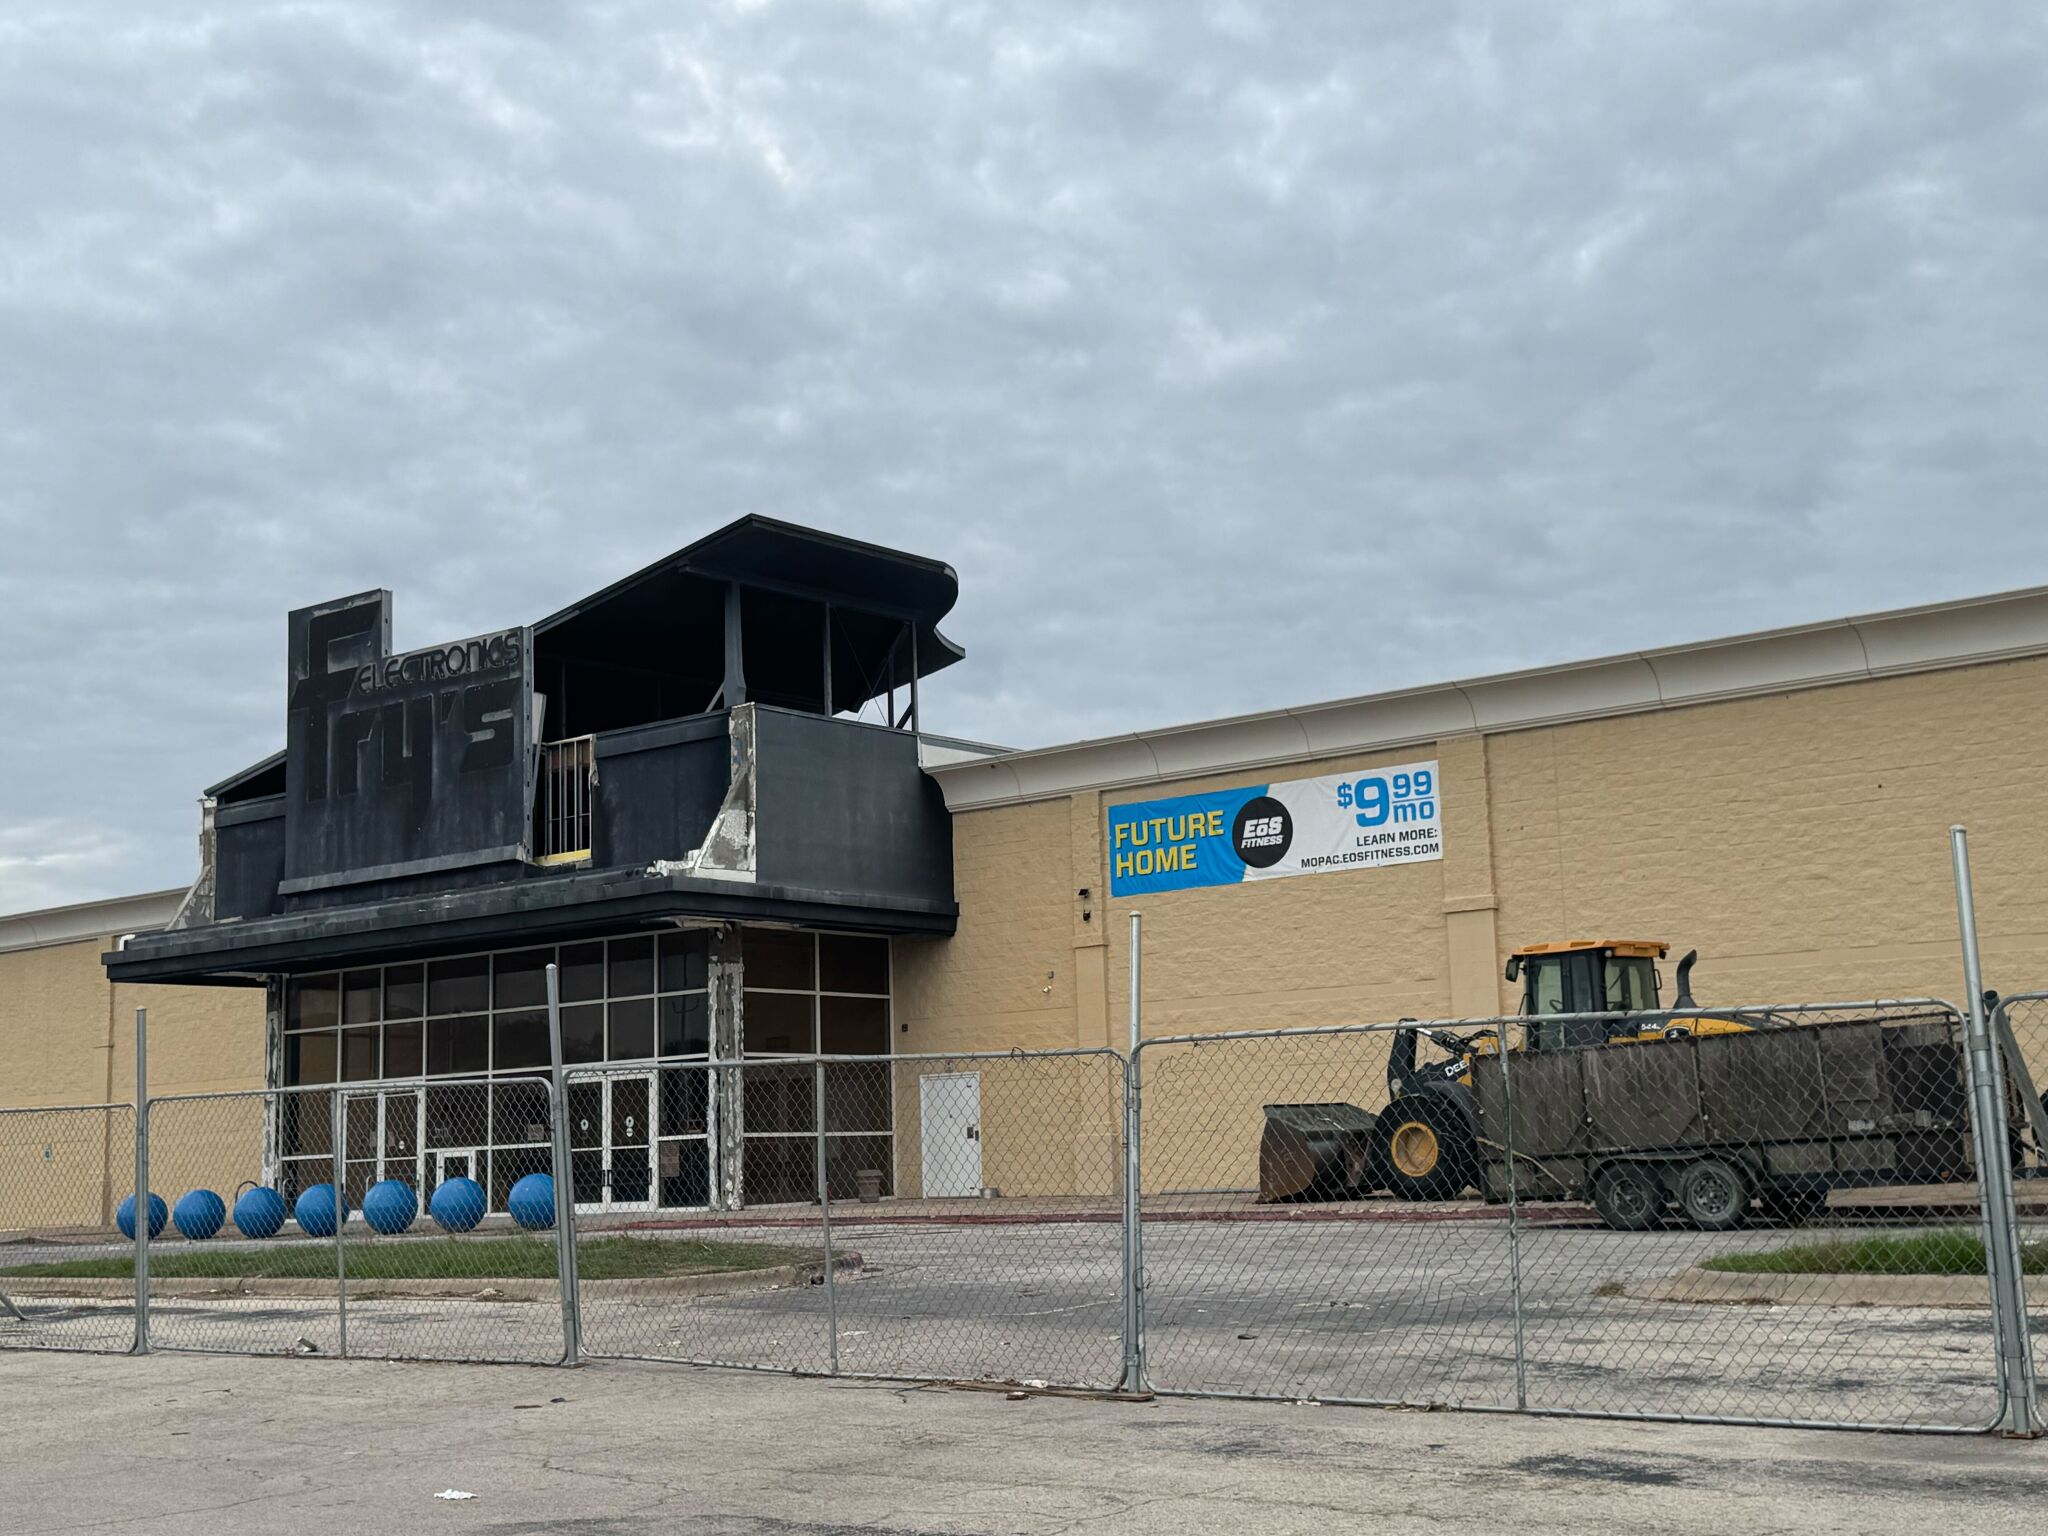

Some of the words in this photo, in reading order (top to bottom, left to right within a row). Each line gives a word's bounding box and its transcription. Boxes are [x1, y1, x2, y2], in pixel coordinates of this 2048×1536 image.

[1115, 810, 1225, 848] FUTURE
[1356, 832, 1396, 848] LEARN
[1398, 828, 1438, 843] MORE:
[1241, 834, 1283, 850] FITNESS
[1116, 844, 1198, 878] HOME
[1300, 843, 1440, 869] MOPAC.EOSFITNESS.COM
[1444, 1060, 1470, 1077] DEE
